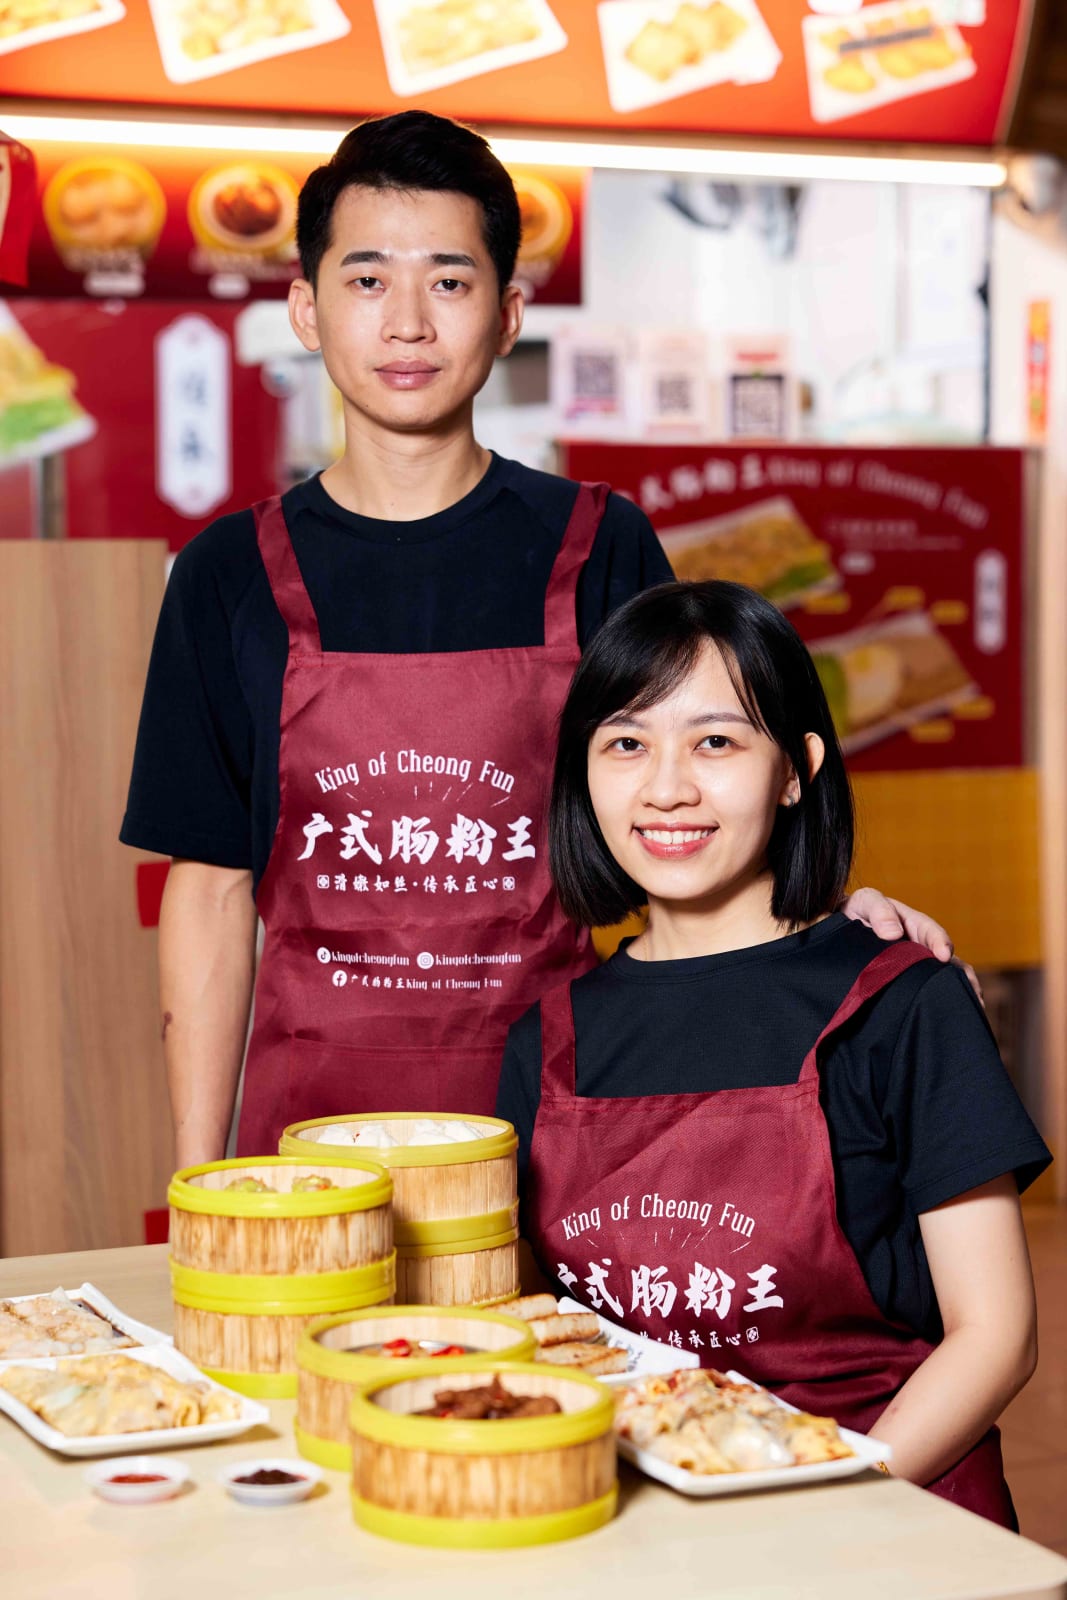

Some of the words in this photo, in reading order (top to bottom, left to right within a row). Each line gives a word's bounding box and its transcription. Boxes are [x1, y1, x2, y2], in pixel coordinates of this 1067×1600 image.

[314, 762, 360, 794] King
[367, 750, 388, 777] of
[396, 748, 473, 783] Cheong
[478, 759, 516, 794] Fun
[297, 809, 536, 866] 广式肠粉王
[561, 1206, 600, 1241] King
[610, 1195, 631, 1221] of
[640, 1192, 713, 1228] Cheong
[718, 1202, 756, 1238] Fun
